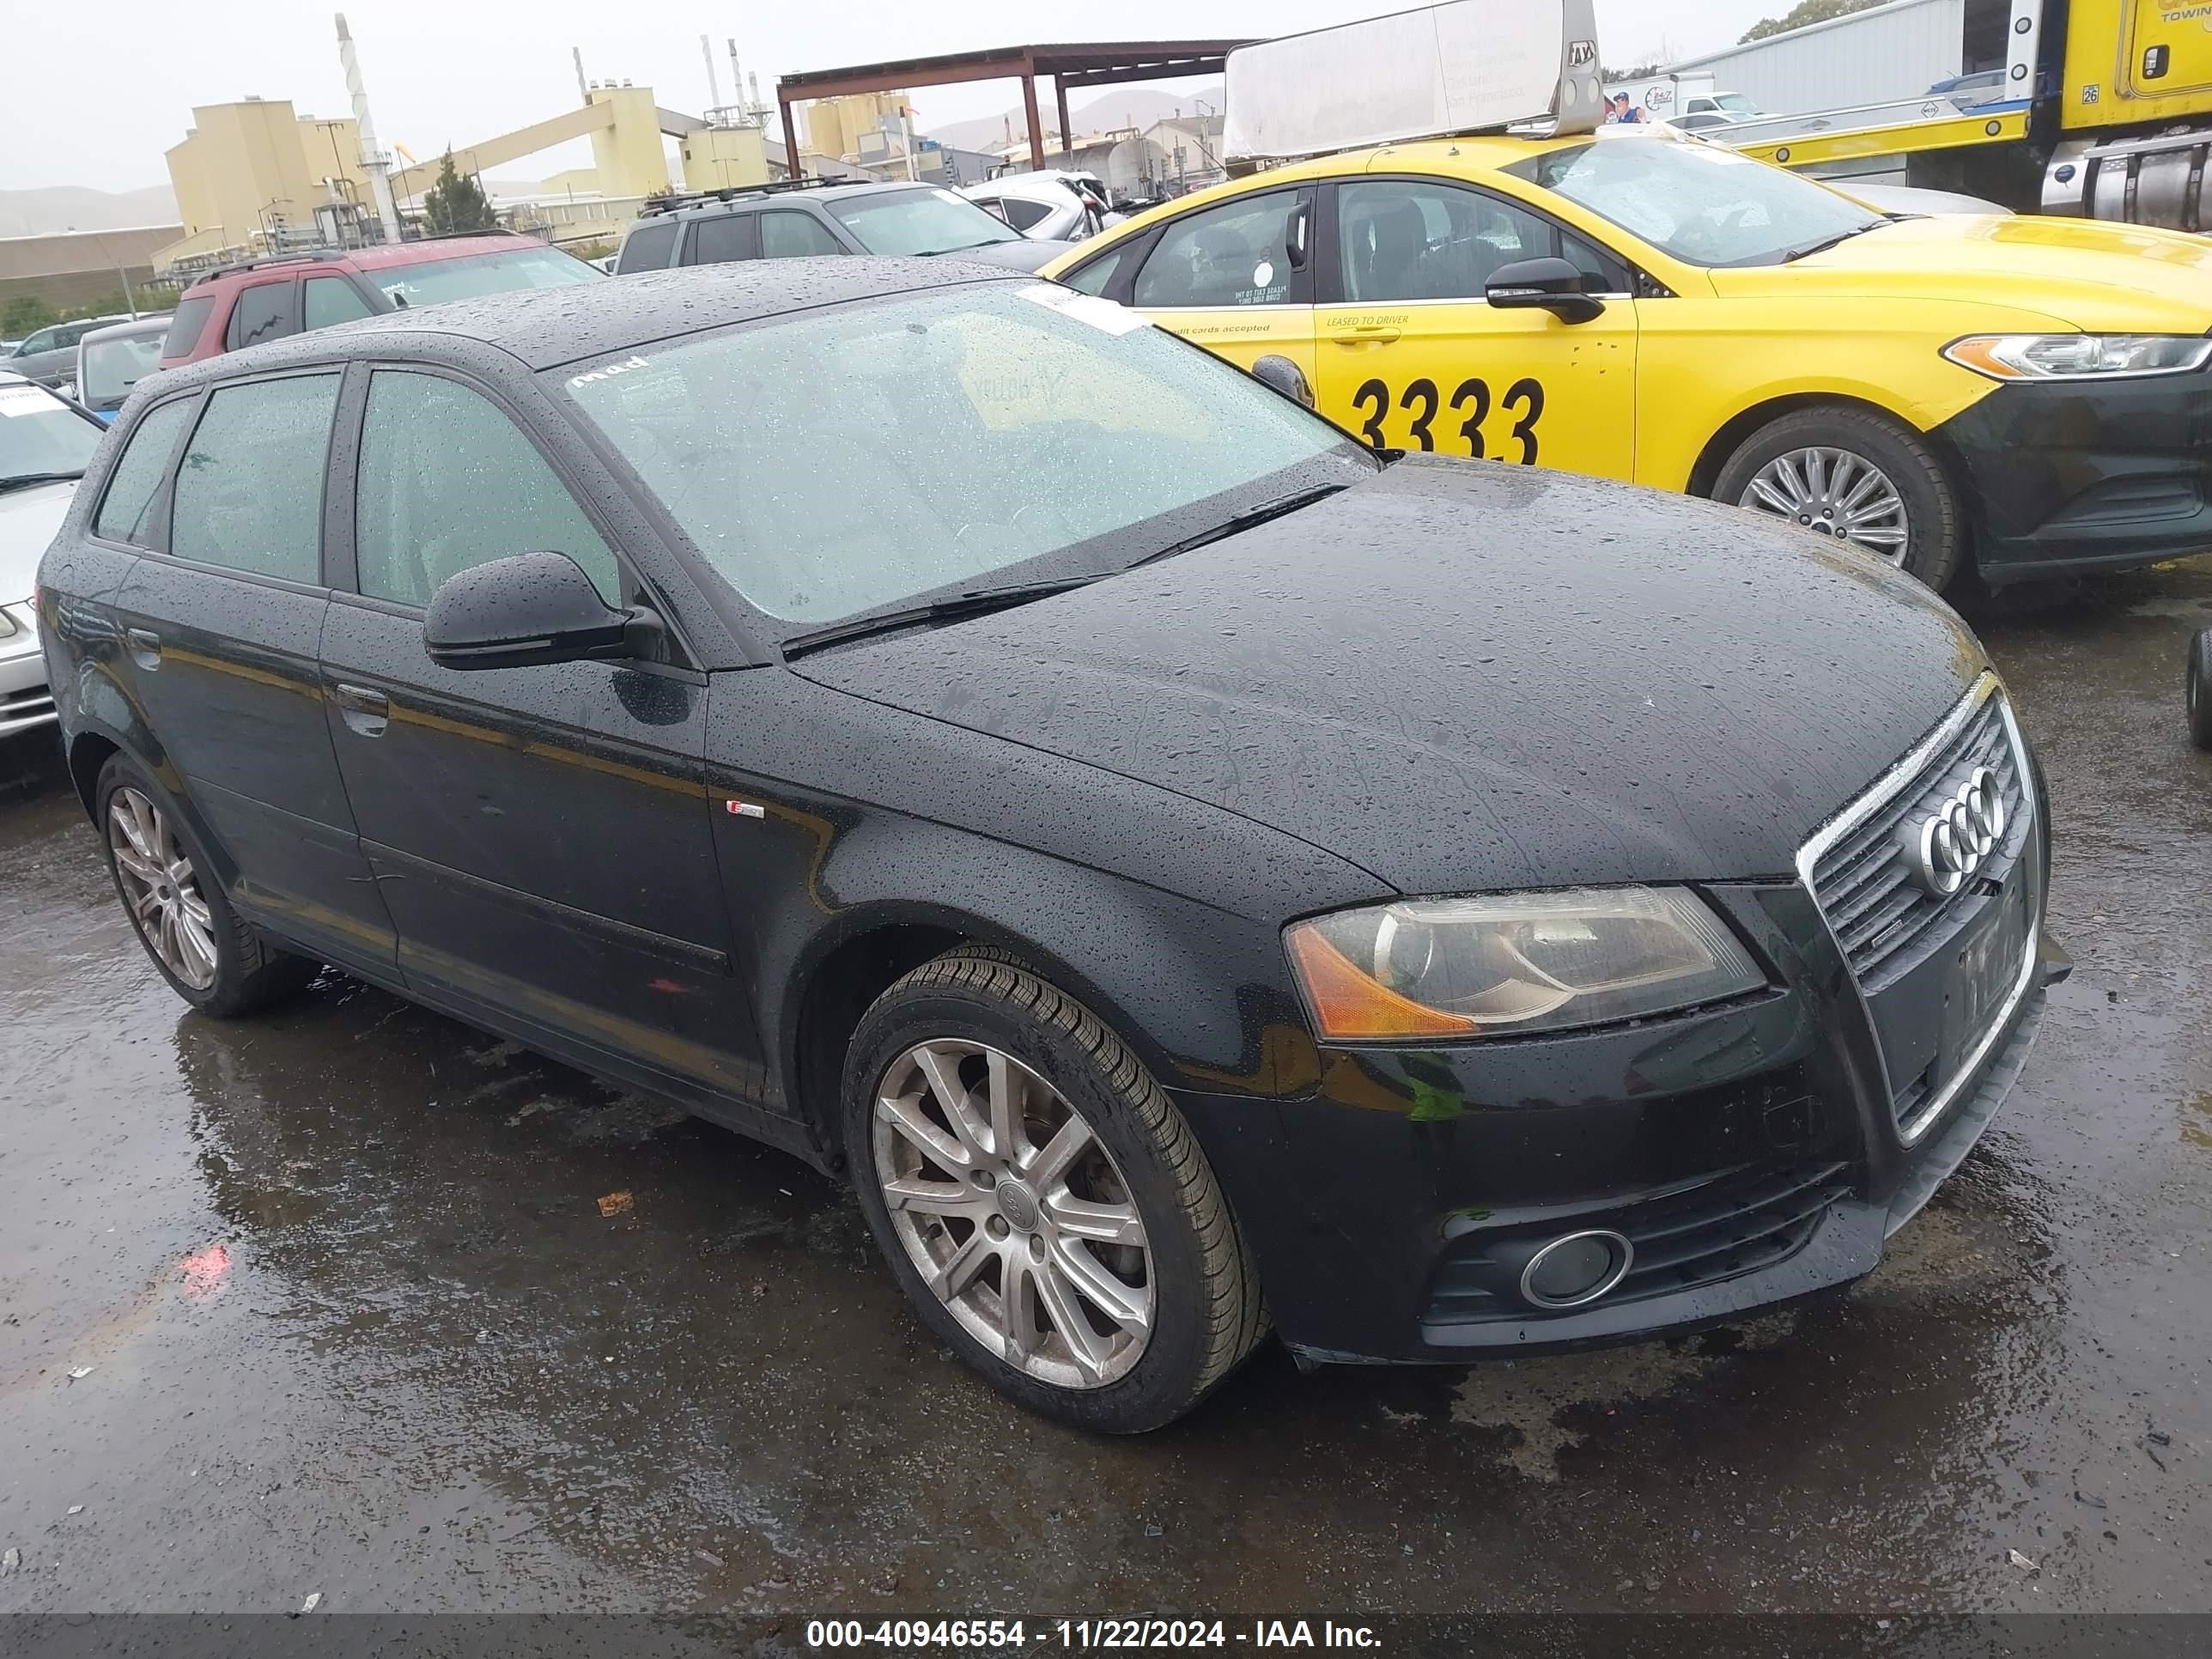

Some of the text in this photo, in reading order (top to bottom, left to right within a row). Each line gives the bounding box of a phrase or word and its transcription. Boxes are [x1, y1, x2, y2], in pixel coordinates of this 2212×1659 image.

[2085, 90, 2097, 102] 26
[1327, 315, 1409, 327] LEASED TO DRIVER
[1192, 325, 1219, 334] cards
[1222, 324, 1270, 333] accepted
[1352, 377, 1545, 465] 3333
